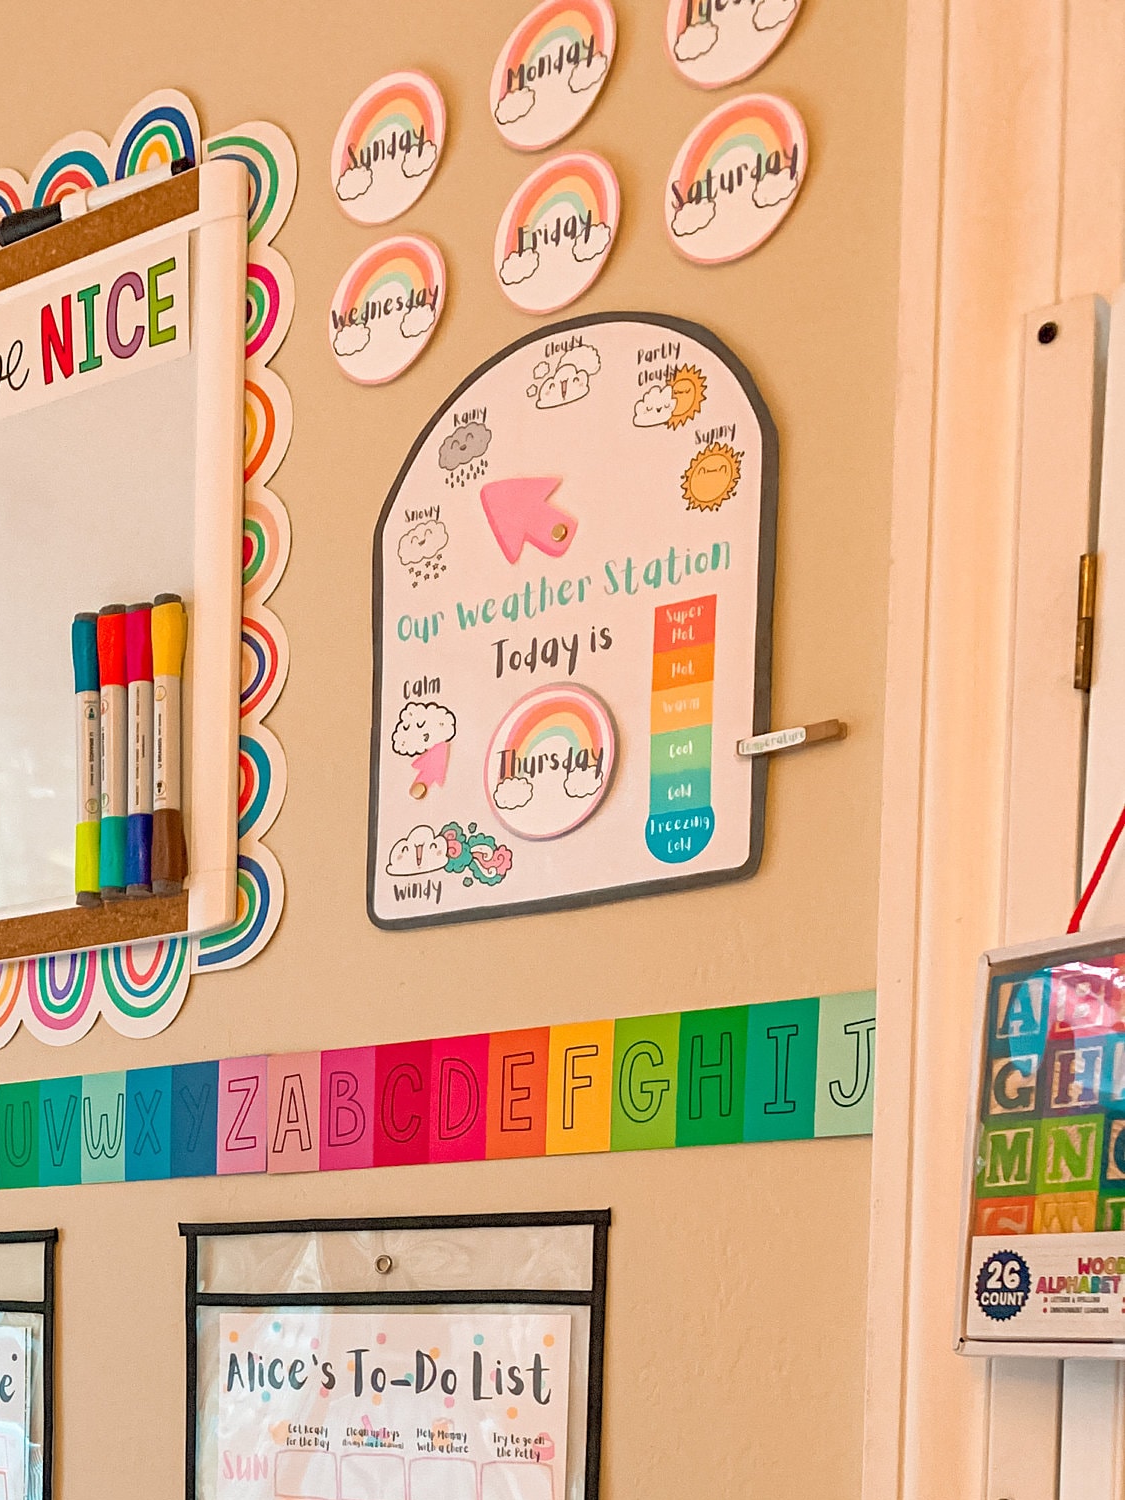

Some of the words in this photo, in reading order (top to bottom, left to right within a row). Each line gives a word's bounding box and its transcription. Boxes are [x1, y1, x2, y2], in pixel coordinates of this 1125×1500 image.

[506, 34, 596, 90] Monday
[348, 125, 426, 170] Sunday
[671, 143, 799, 209] Saturday
[516, 209, 592, 257] Friday
[331, 285, 439, 329] Wednesday
[40, 256, 177, 386] NICE
[544, 335, 584, 358] Cloudy
[637, 342, 682, 364] Partly
[638, 363, 678, 386] Cloudy
[453, 406, 487, 426] Rainy
[694, 422, 736, 445] Sunny
[403, 505, 441, 523] Snowy
[397, 609, 445, 643] Our
[456, 576, 592, 631] Weather
[603, 540, 731, 596] Station
[665, 603, 704, 625] Super
[671, 625, 695, 644] Hot
[491, 635, 579, 679] Today
[590, 626, 613, 653] is
[671, 659, 695, 677] Hot
[669, 742, 693, 758] Cool
[496, 746, 604, 780] Thursday
[668, 782, 692, 800] Cold
[649, 815, 711, 837] Freezing
[668, 835, 692, 854] Cold
[393, 883, 443, 905] Windy
[987, 1260, 1021, 1290] 26
[1036, 1276, 1121, 1294] ALPHABET
[980, 1292, 1025, 1306] COUNT
[226, 1351, 336, 1393] Alice's
[346, 1348, 457, 1397] To-Do
[473, 1351, 552, 1406] List
[222, 1451, 269, 1481] SUN
